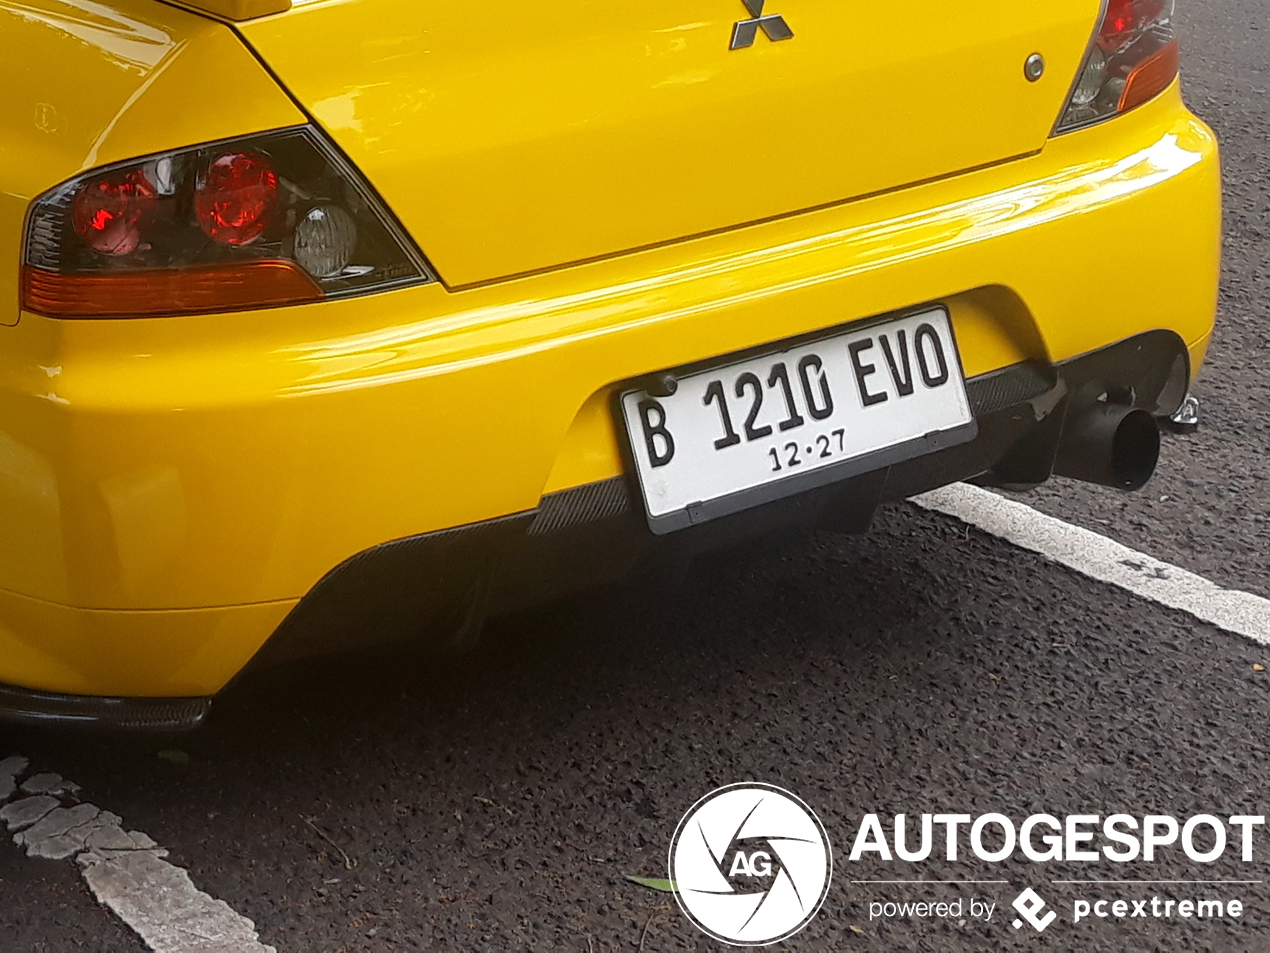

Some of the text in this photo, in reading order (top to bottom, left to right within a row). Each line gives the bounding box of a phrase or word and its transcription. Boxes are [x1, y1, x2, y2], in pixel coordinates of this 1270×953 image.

[637, 322, 950, 469] B 1210 EVO
